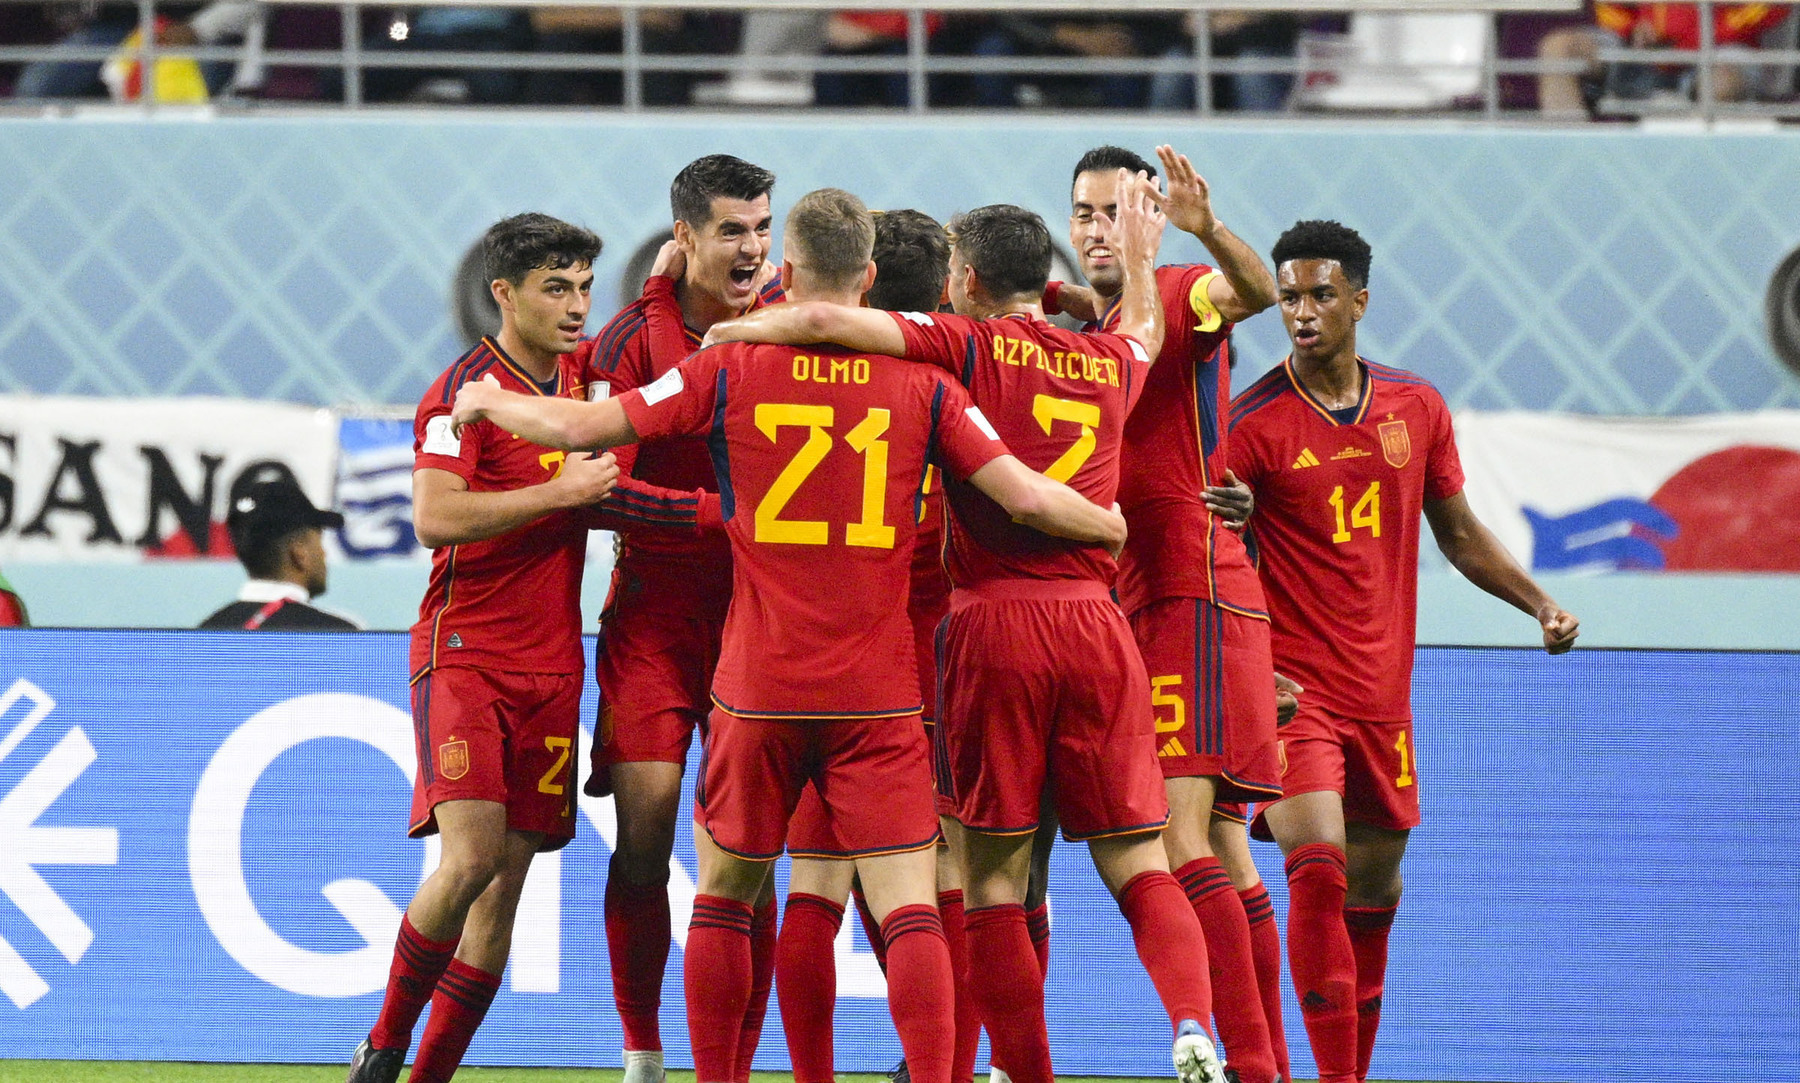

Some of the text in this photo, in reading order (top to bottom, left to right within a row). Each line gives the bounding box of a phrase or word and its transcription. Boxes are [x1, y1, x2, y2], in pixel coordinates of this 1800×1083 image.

[792, 355, 870, 385] OLMO
[993, 334, 1120, 388] AZPILICUETA
[0, 432, 300, 553] AN
[754, 403, 896, 549] 21
[1328, 480, 1381, 544] 14
[1151, 674, 1186, 733] 5
